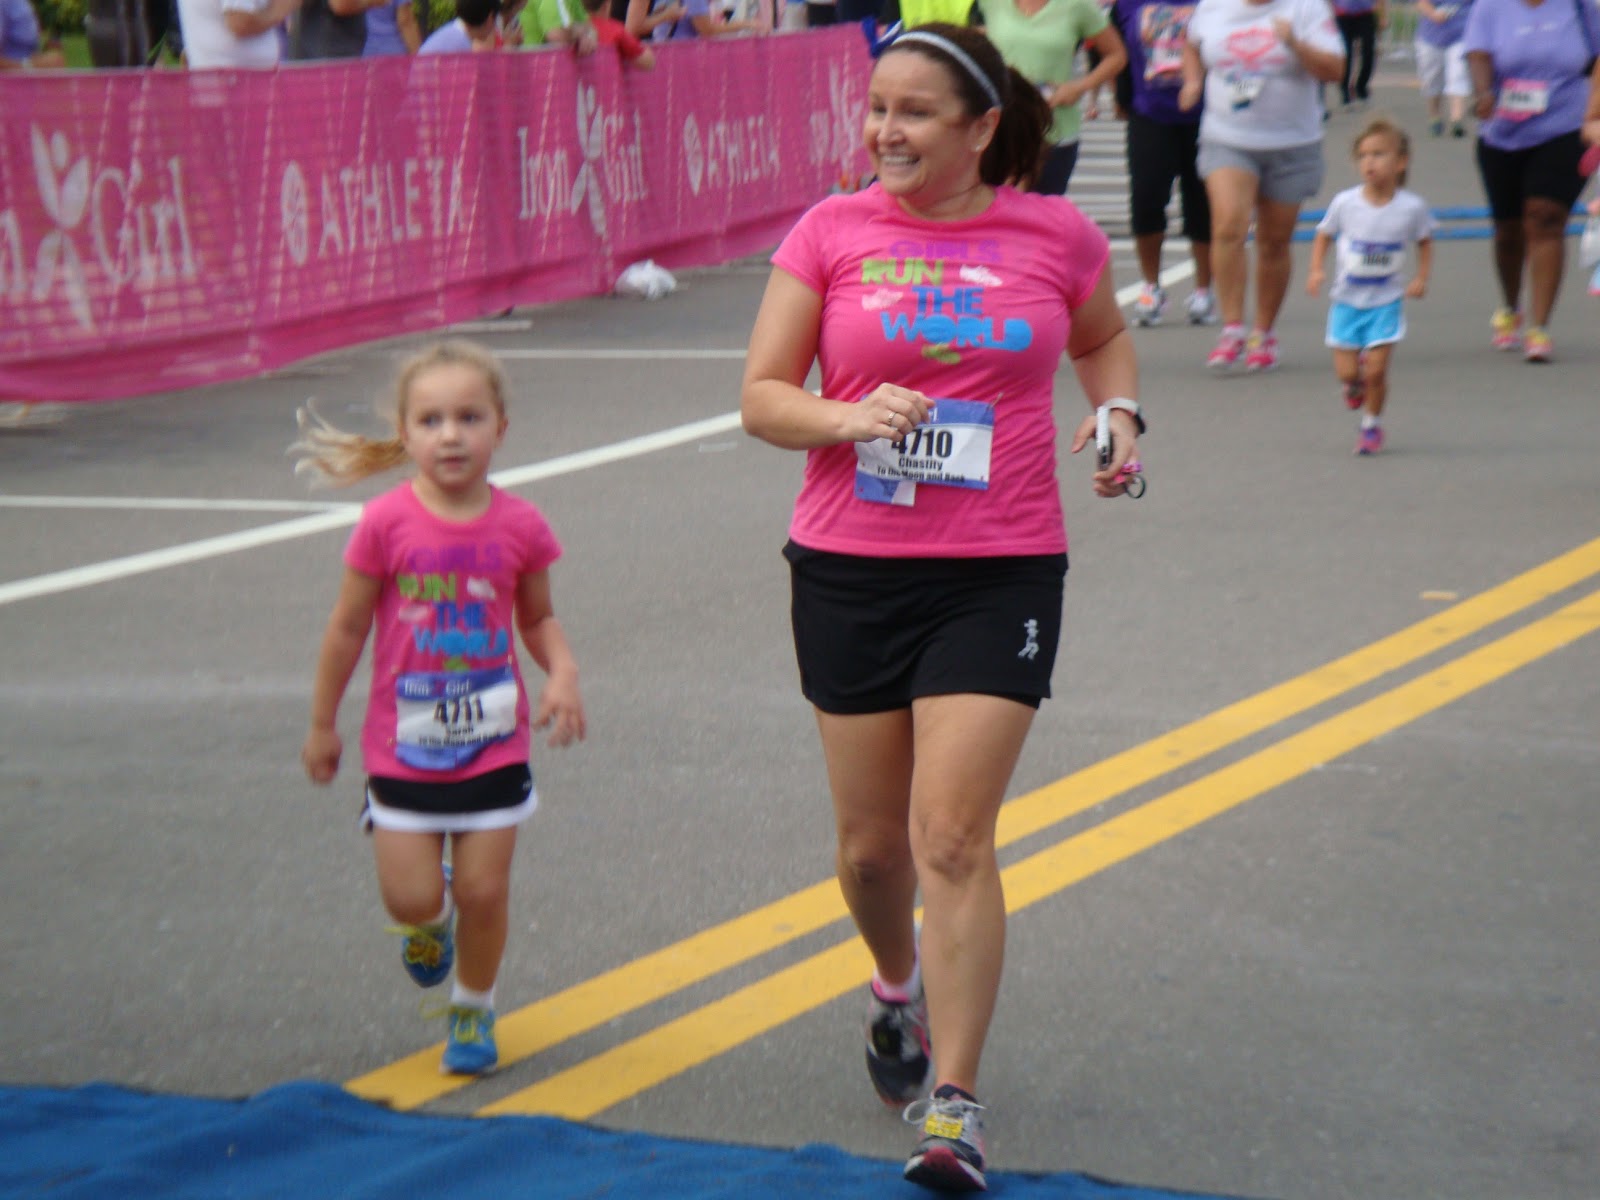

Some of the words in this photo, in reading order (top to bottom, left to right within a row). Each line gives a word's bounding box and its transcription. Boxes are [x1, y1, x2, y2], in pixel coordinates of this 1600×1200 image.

[518, 126, 570, 220] Iron
[603, 110, 647, 206] Girl
[92, 156, 196, 283] Girl
[318, 156, 466, 257] ATHLETA
[889, 239, 1002, 262] GIRLS
[861, 258, 944, 286] RUN
[912, 286, 984, 315] THE
[880, 312, 1033, 352] WORLD
[891, 429, 953, 458] 4710
[898, 457, 943, 471] Chastity
[397, 572, 456, 602] RUN
[433, 601, 486, 630] THE
[413, 625, 509, 659] WORLD
[434, 696, 484, 724] 4711
